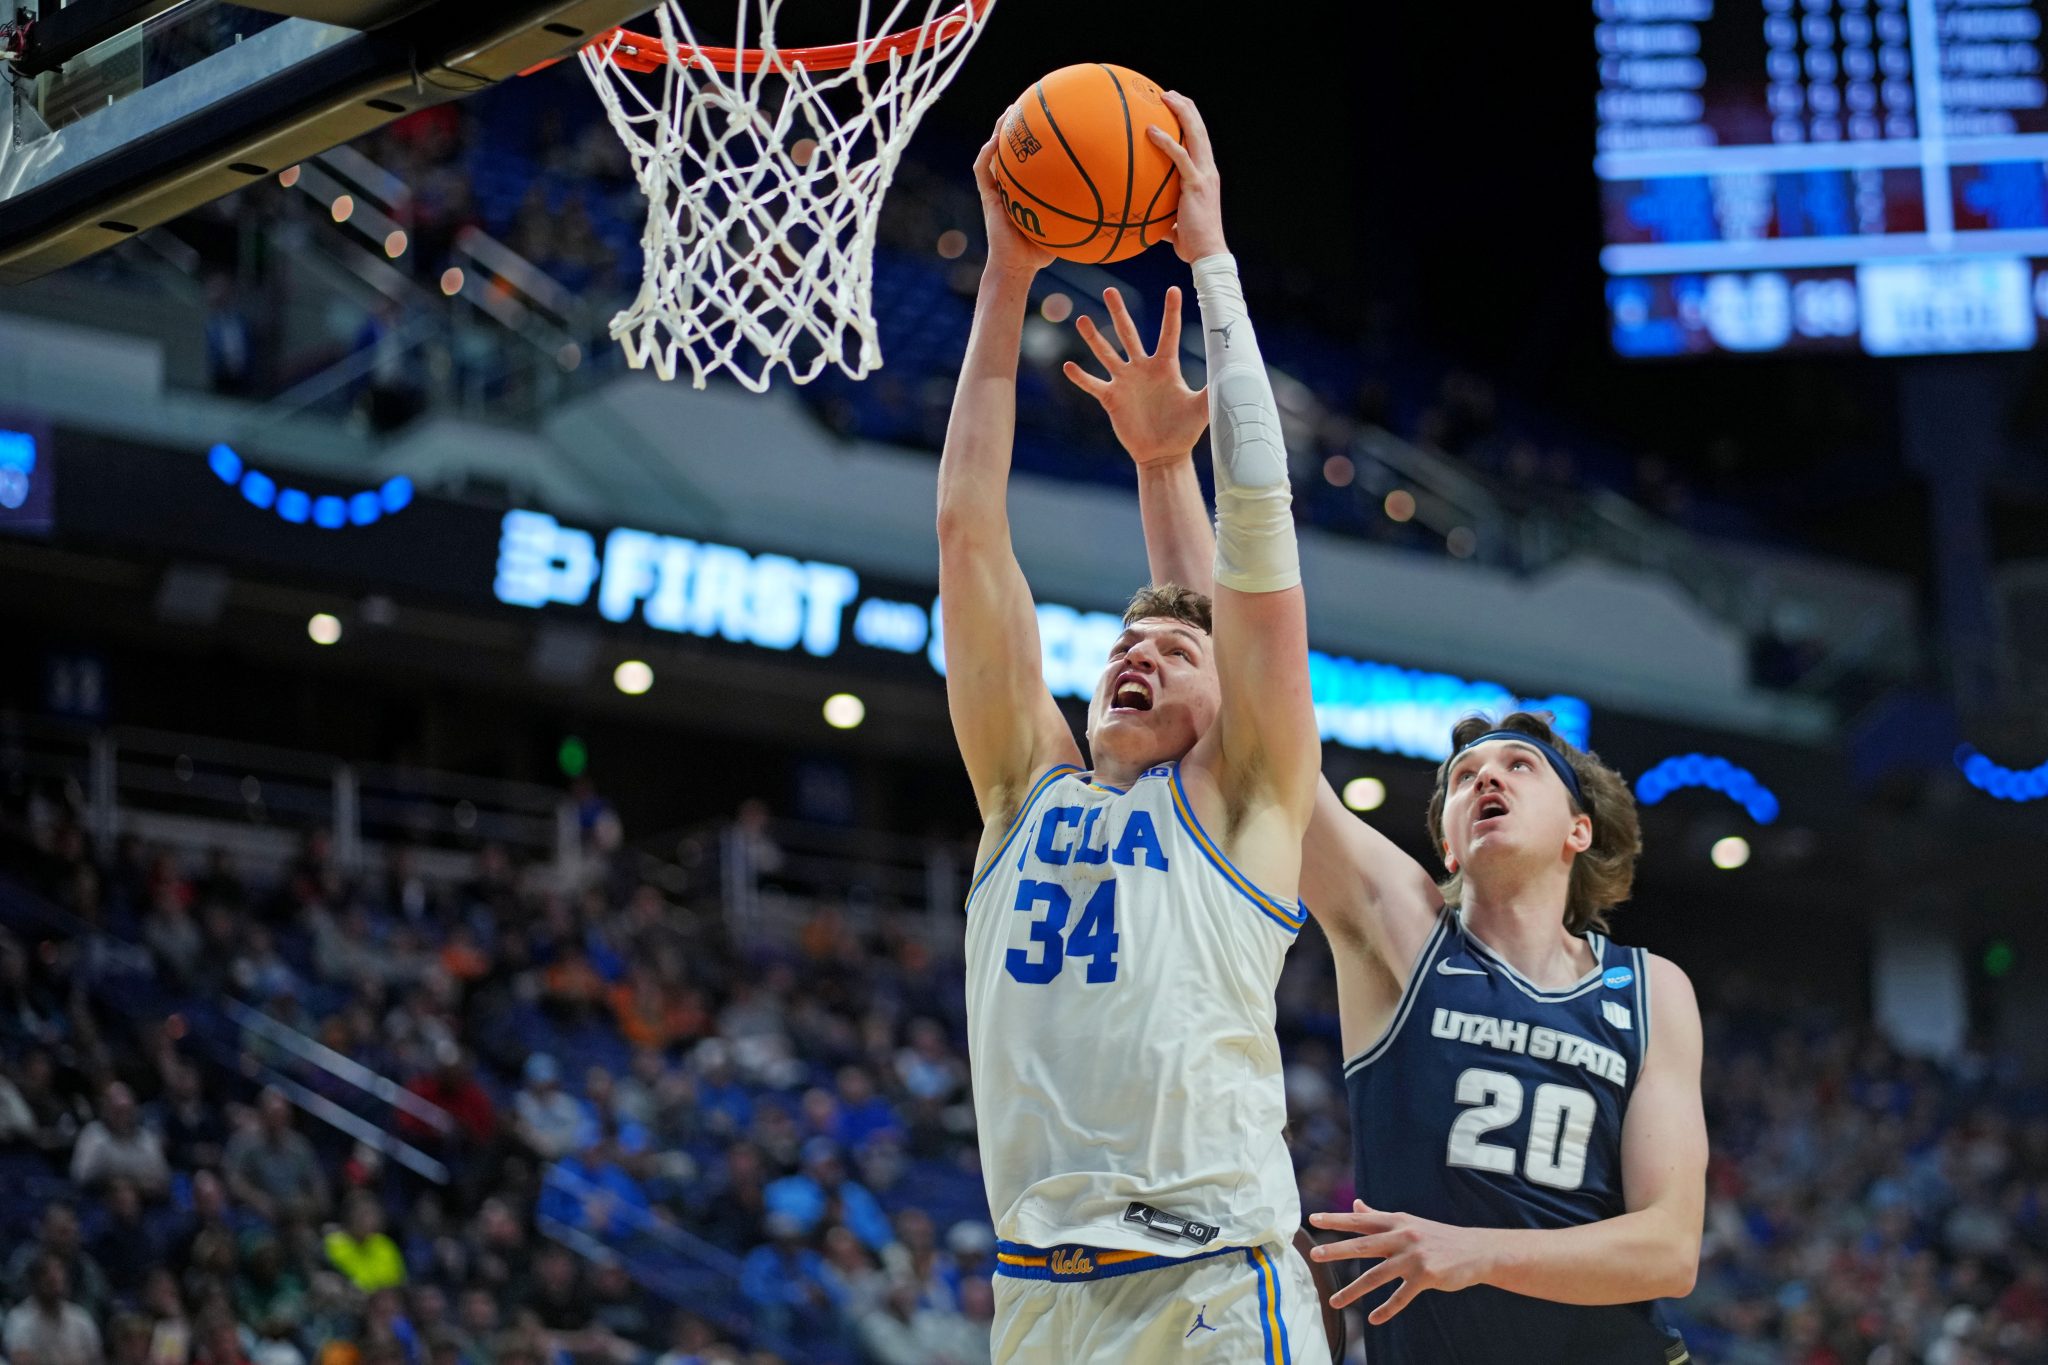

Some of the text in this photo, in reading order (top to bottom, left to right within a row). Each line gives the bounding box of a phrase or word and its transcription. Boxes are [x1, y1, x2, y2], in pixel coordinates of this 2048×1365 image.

[599, 527, 859, 657] FIRST
[1017, 806, 1169, 872] CLA
[1005, 878, 1120, 985] 34
[1431, 1007, 1627, 1088] UTAH STATE
[1446, 1067, 1597, 1191] 20
[1188, 1223, 1205, 1238] 50
